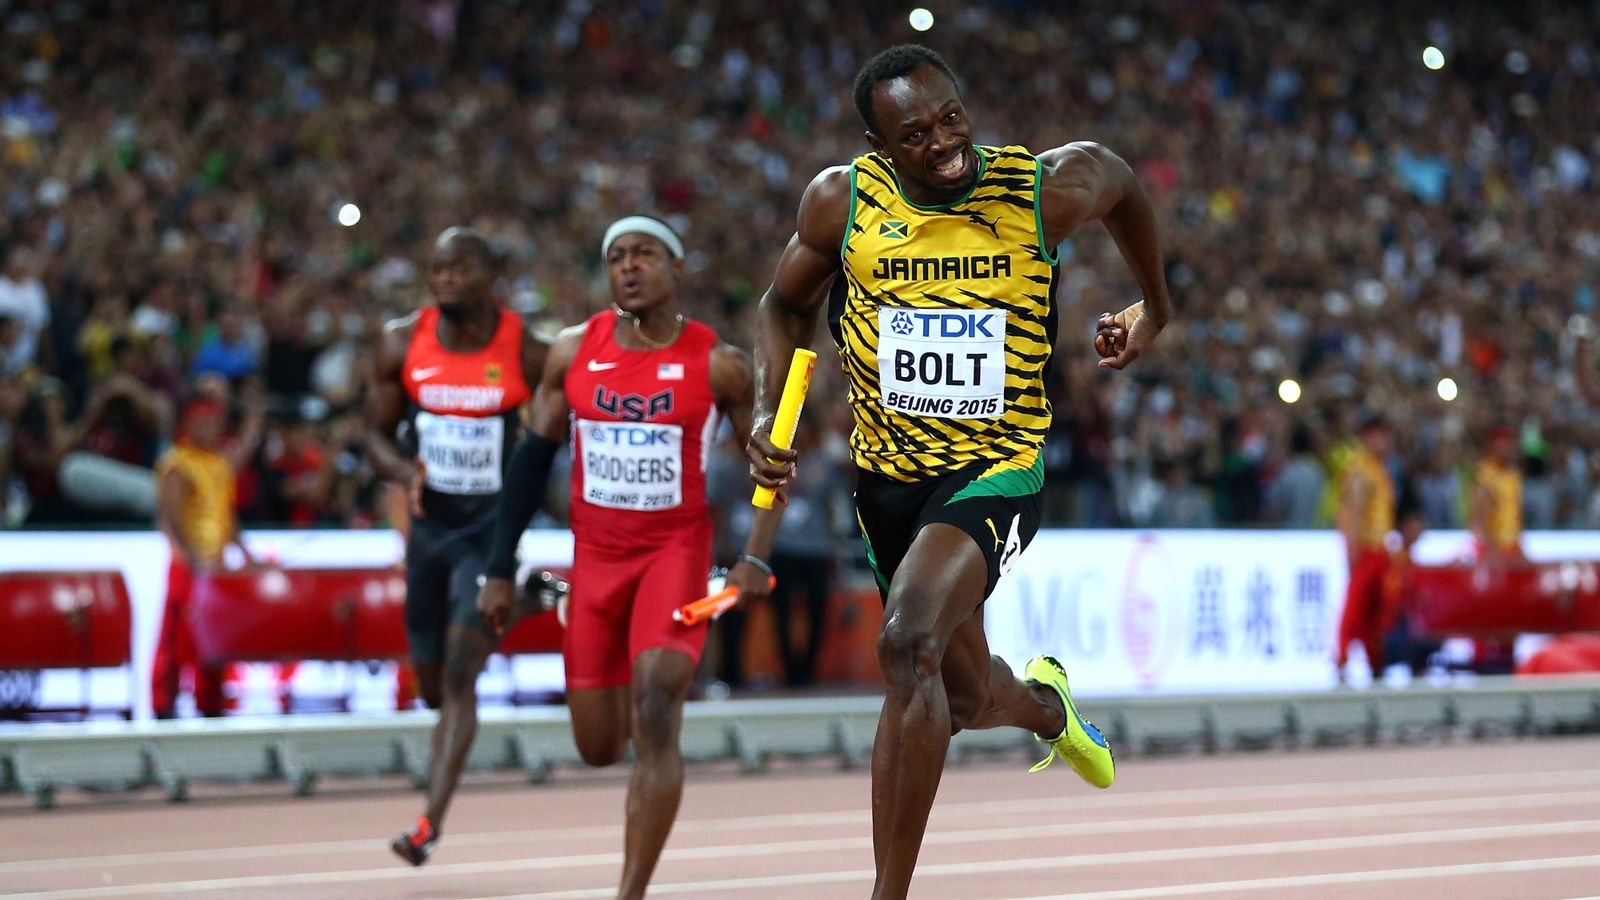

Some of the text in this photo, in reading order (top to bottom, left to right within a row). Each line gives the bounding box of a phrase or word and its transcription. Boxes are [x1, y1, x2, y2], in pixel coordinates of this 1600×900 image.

[873, 254, 1012, 280] JAMAICA
[914, 313, 994, 338] TDK
[894, 349, 988, 386] BOLT
[593, 384, 674, 422] USA
[887, 392, 999, 415] BEIJING 2015
[608, 427, 670, 446] TDK
[588, 451, 676, 484] RODGERS
